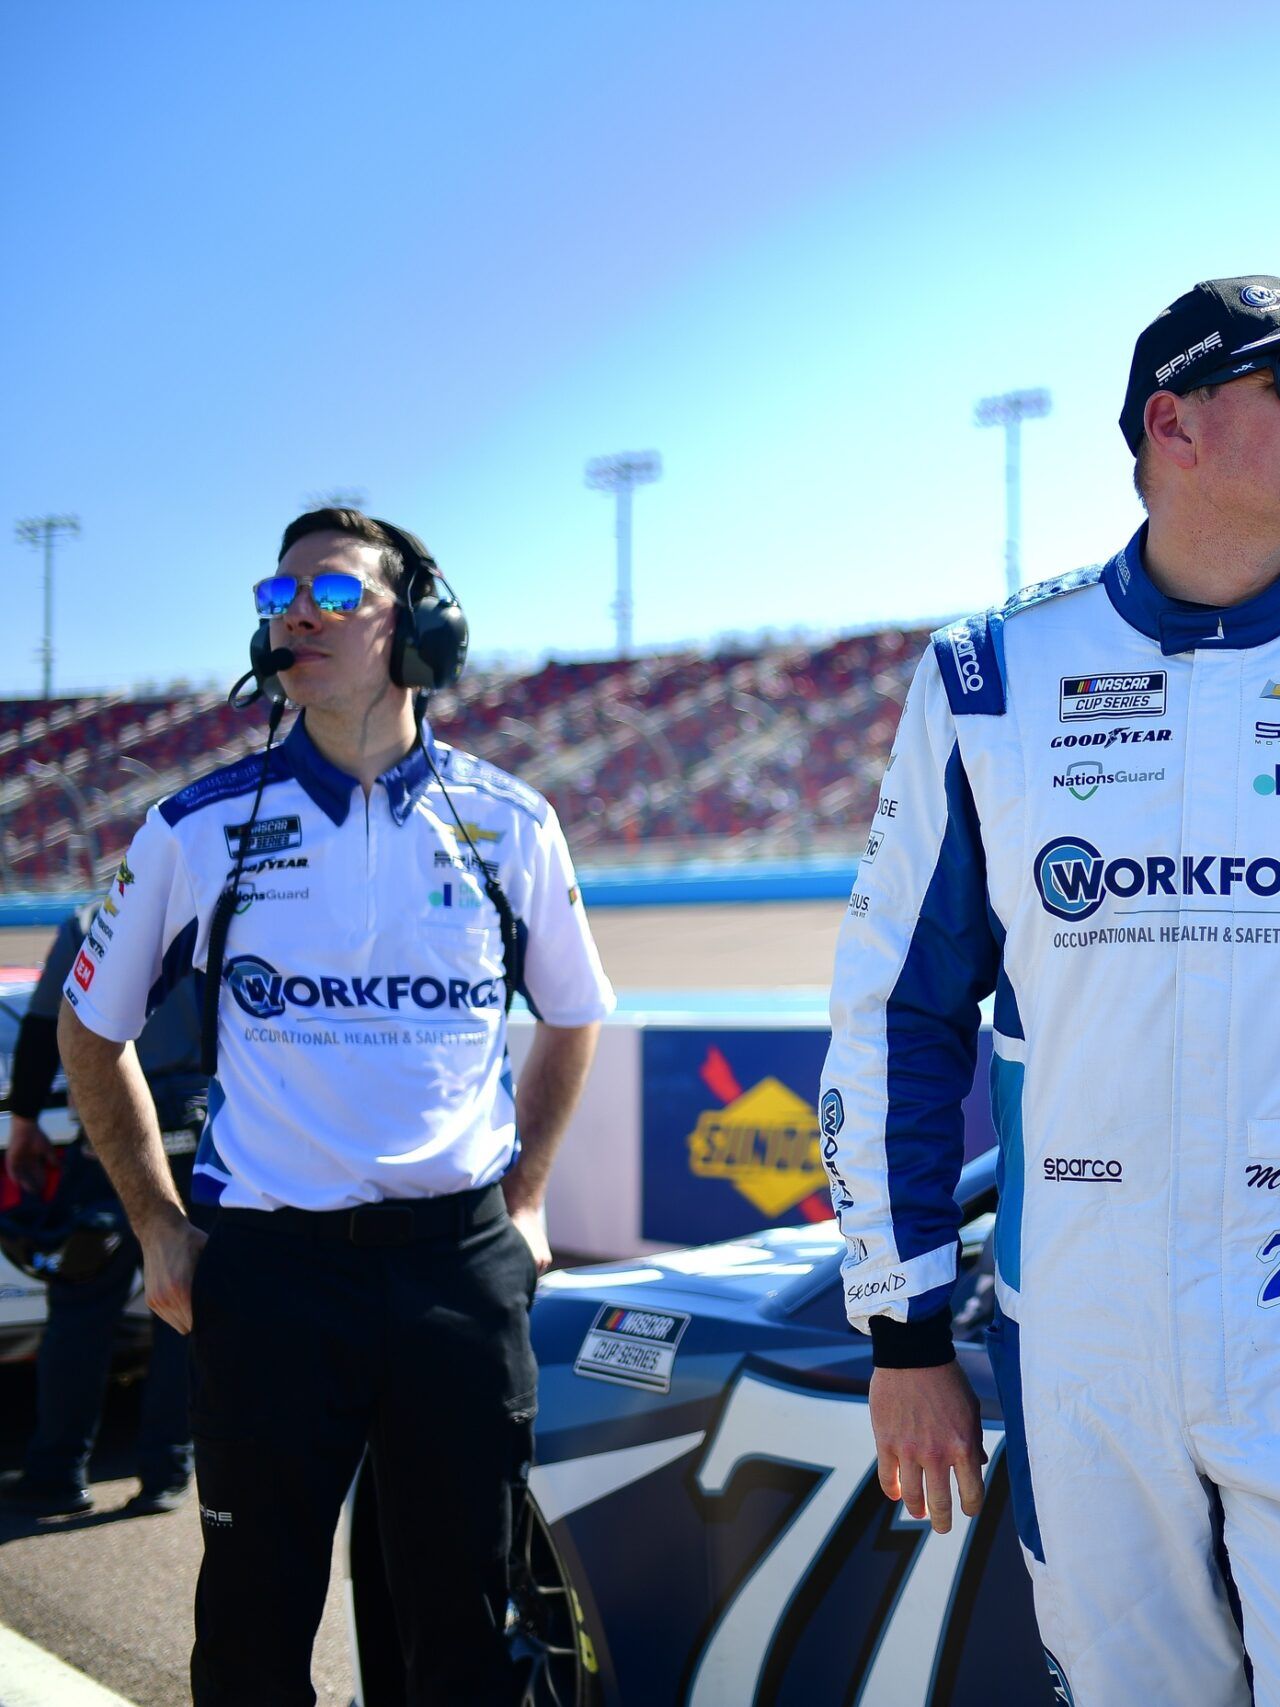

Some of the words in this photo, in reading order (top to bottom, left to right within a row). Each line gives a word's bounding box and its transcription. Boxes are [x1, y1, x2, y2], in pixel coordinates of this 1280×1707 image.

[948, 626, 983, 694] parco
[1094, 676, 1150, 692] NASCAR
[1076, 697, 1101, 711] CUP
[1103, 695, 1150, 709] SERIES
[1051, 728, 1172, 748] GOODYEAR
[1053, 768, 1165, 788] NationsGuard
[1054, 927, 1155, 948] OCCUPATIONAL
[1160, 926, 1218, 943] HEALTH
[1223, 928, 1232, 943] &
[344, 1031, 398, 1045] HEALTH
[701, 1123, 820, 1172] SUNOC
[1044, 1158, 1122, 1181] sparco
[848, 1273, 907, 1302] SECOND
[621, 1311, 675, 1339] NASCAR
[618, 1344, 661, 1371] SERIES
